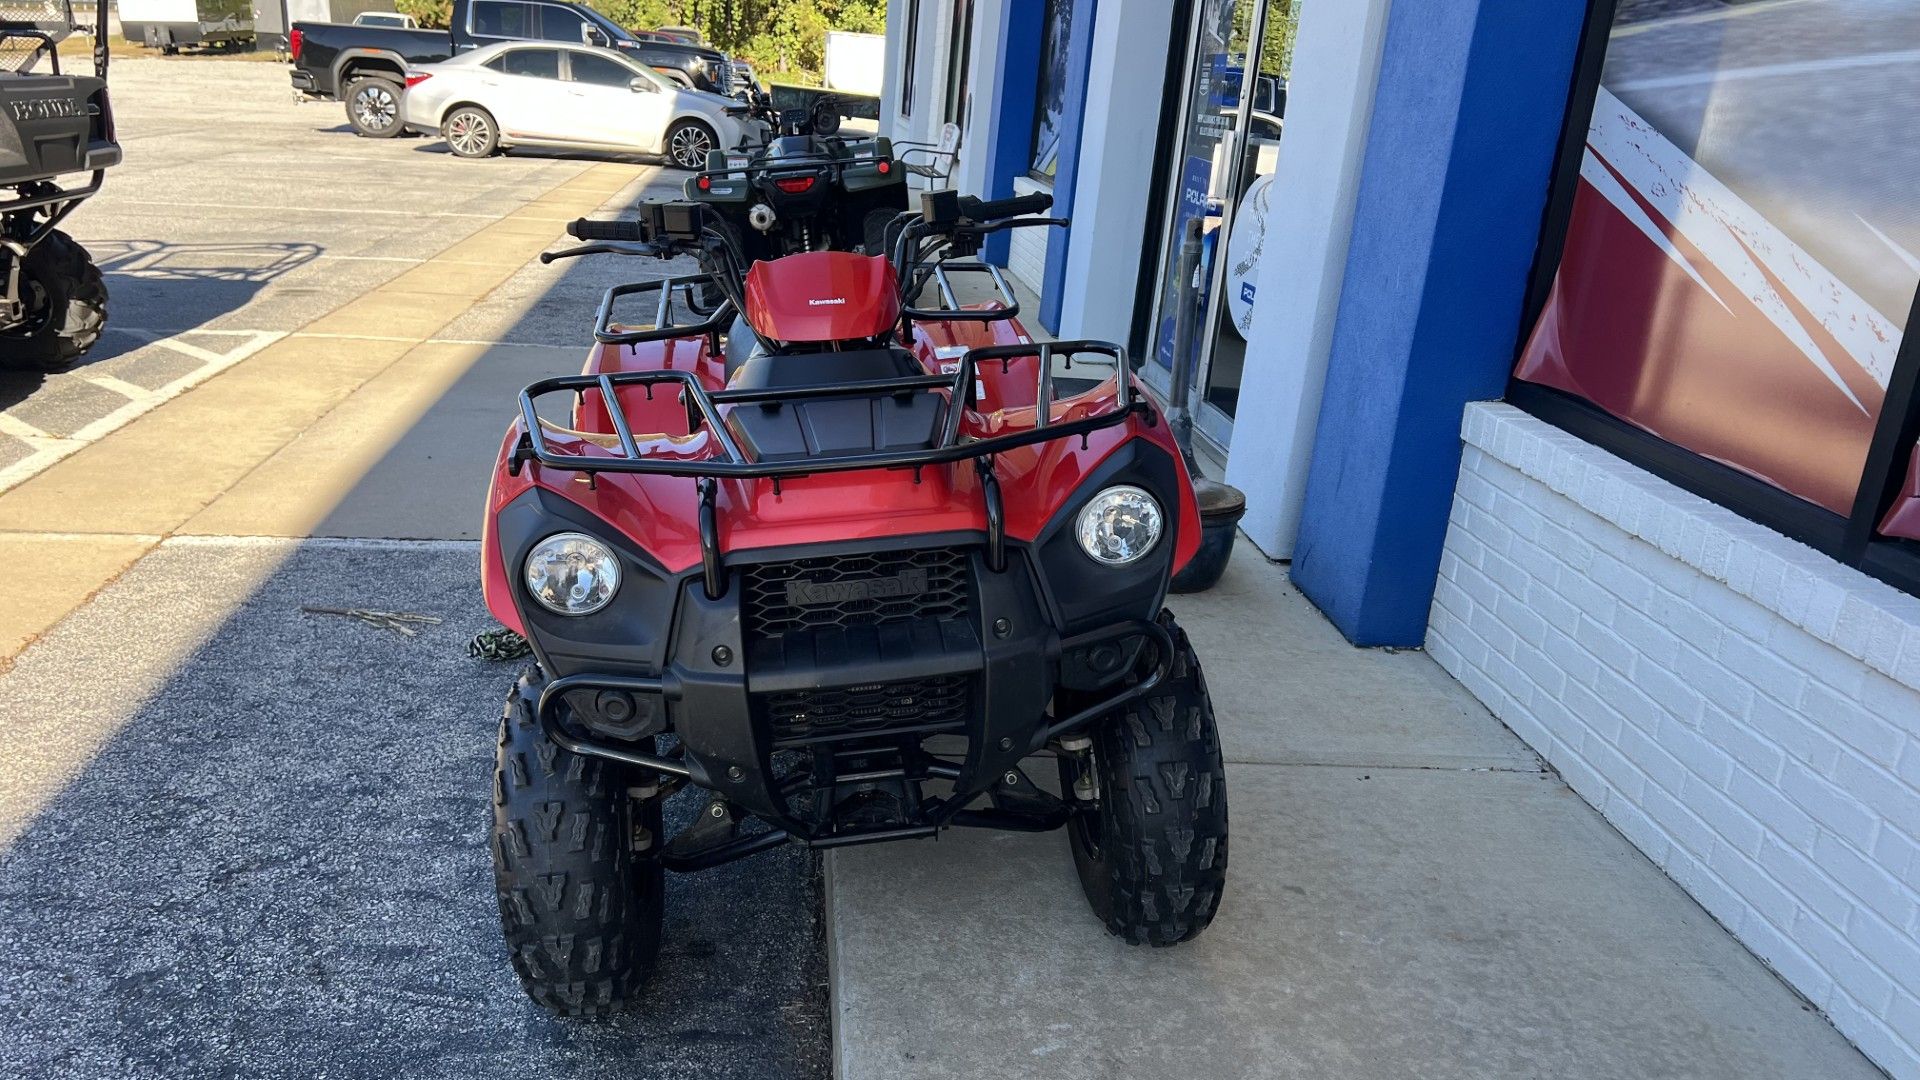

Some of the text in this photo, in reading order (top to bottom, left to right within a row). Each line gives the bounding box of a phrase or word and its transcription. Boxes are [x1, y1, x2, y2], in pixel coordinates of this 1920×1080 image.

[10, 98, 88, 121] HONDA
[808, 298, 845, 306] Kawasaki
[787, 568, 928, 606] Kawasaki
